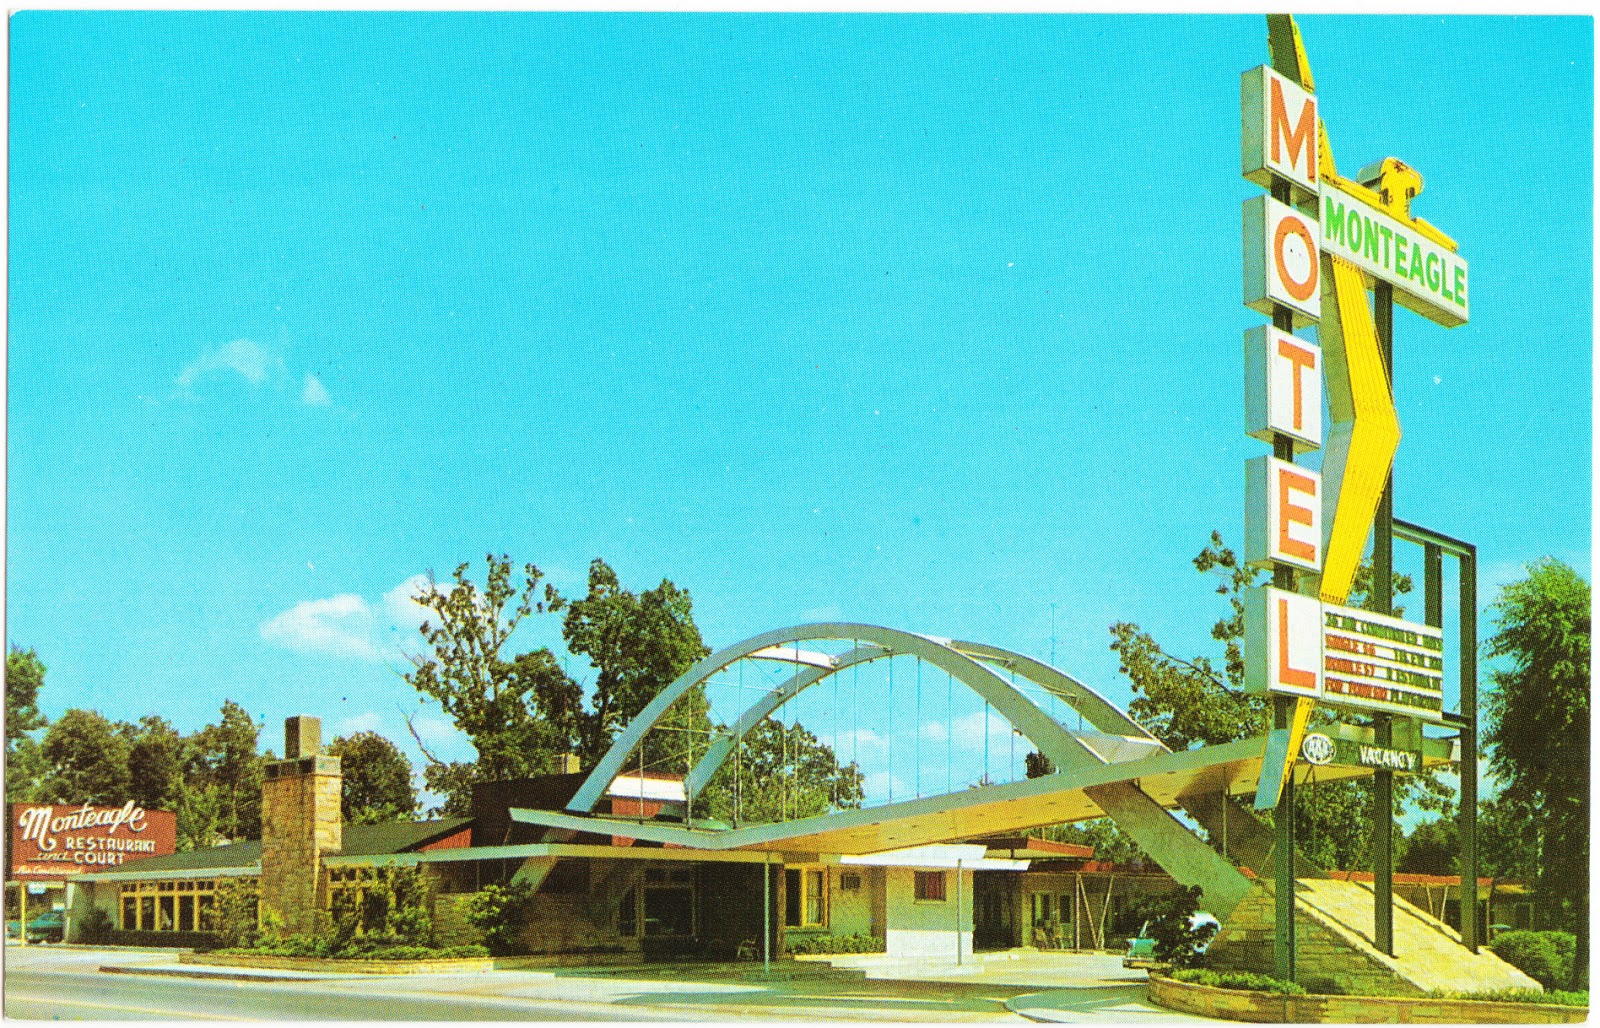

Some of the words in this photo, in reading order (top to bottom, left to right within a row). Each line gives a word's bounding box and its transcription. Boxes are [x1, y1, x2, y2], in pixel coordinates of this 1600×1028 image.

[1325, 196, 1466, 308] MONTEAGLE
[1270, 75, 1319, 689] MOTEL
[1360, 745, 1416, 770] VACANCY
[19, 799, 148, 852] Monteagle
[66, 837, 156, 853] RESTAURANT
[73, 852, 126, 865] COURT
